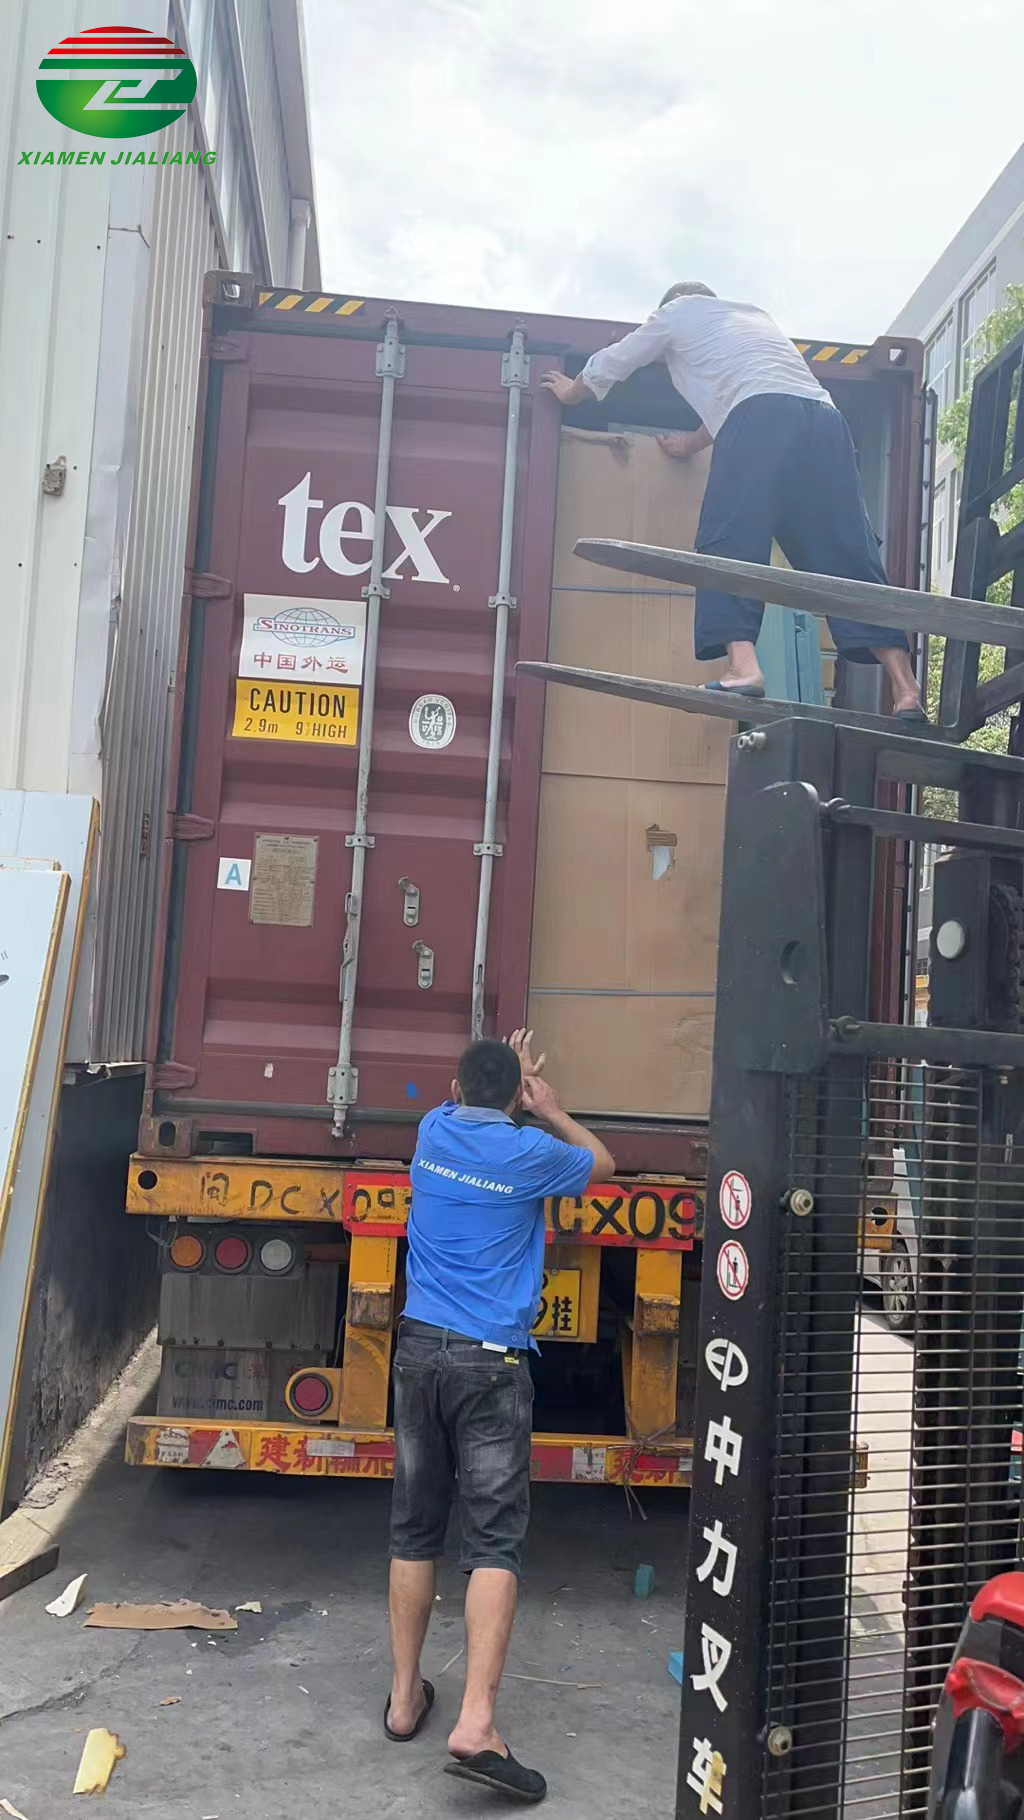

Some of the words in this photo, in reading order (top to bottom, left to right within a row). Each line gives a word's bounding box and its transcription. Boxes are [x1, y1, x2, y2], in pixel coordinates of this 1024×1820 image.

[278, 471, 452, 584] tex
[260, 619, 352, 636] SINOTRANS
[253, 651, 349, 674] 中国外运
[249, 687, 346, 719] CAUTION
[224, 863, 242, 886] A
[417, 1158, 459, 1180] XIAMEN
[457, 1174, 514, 1194] JIALIANG
